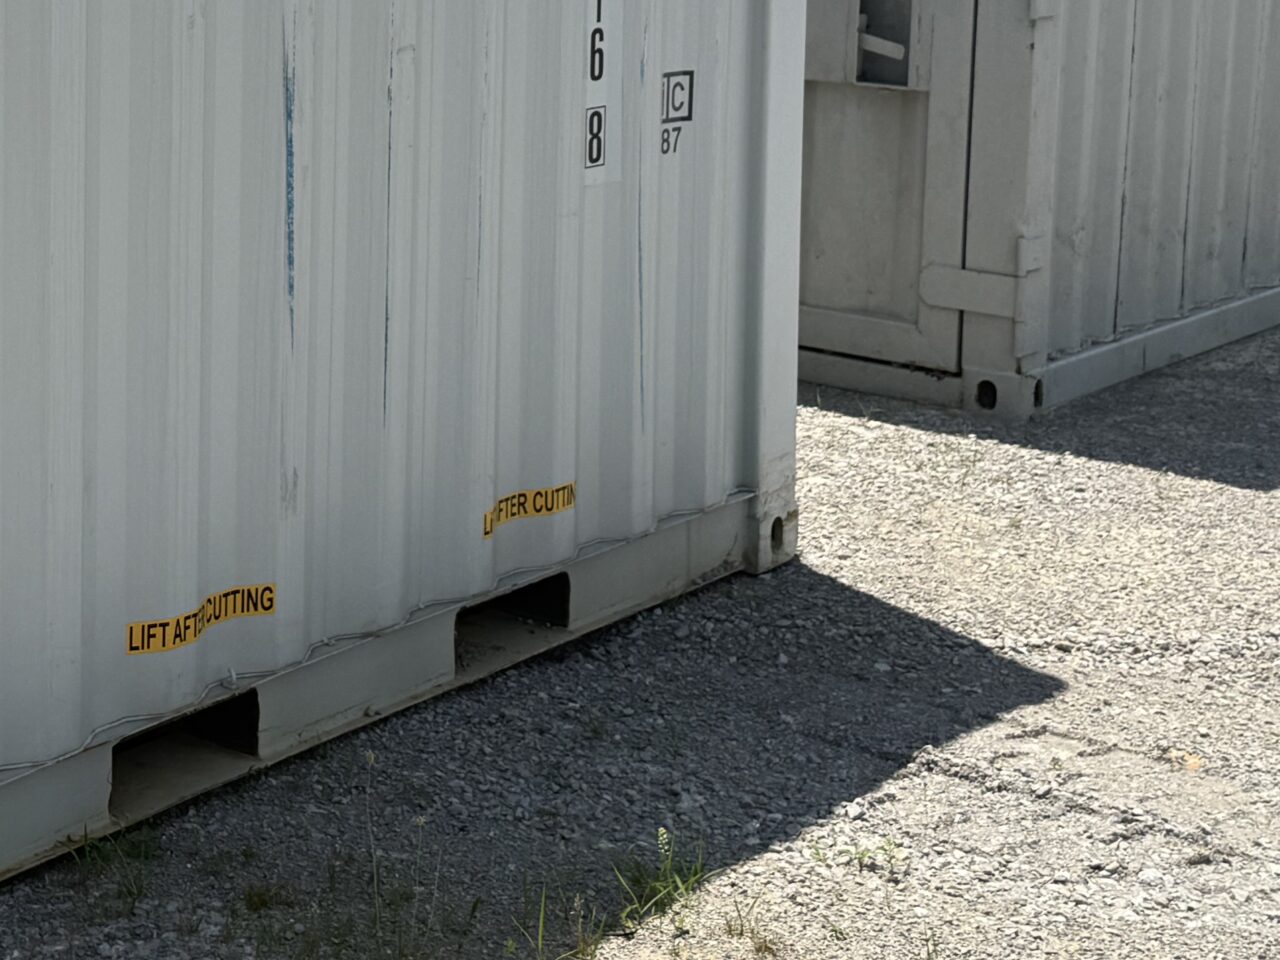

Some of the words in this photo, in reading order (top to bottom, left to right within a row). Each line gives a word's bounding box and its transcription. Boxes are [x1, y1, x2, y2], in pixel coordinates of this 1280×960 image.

[588, 110, 602, 164] 8
[661, 126, 682, 155] 87
[483, 512, 493, 536] LI
[493, 492, 528, 522] FTER
[532, 483, 576, 513] CUTTIN
[129, 622, 170, 652] LIFT
[206, 586, 274, 624] CUTTING
